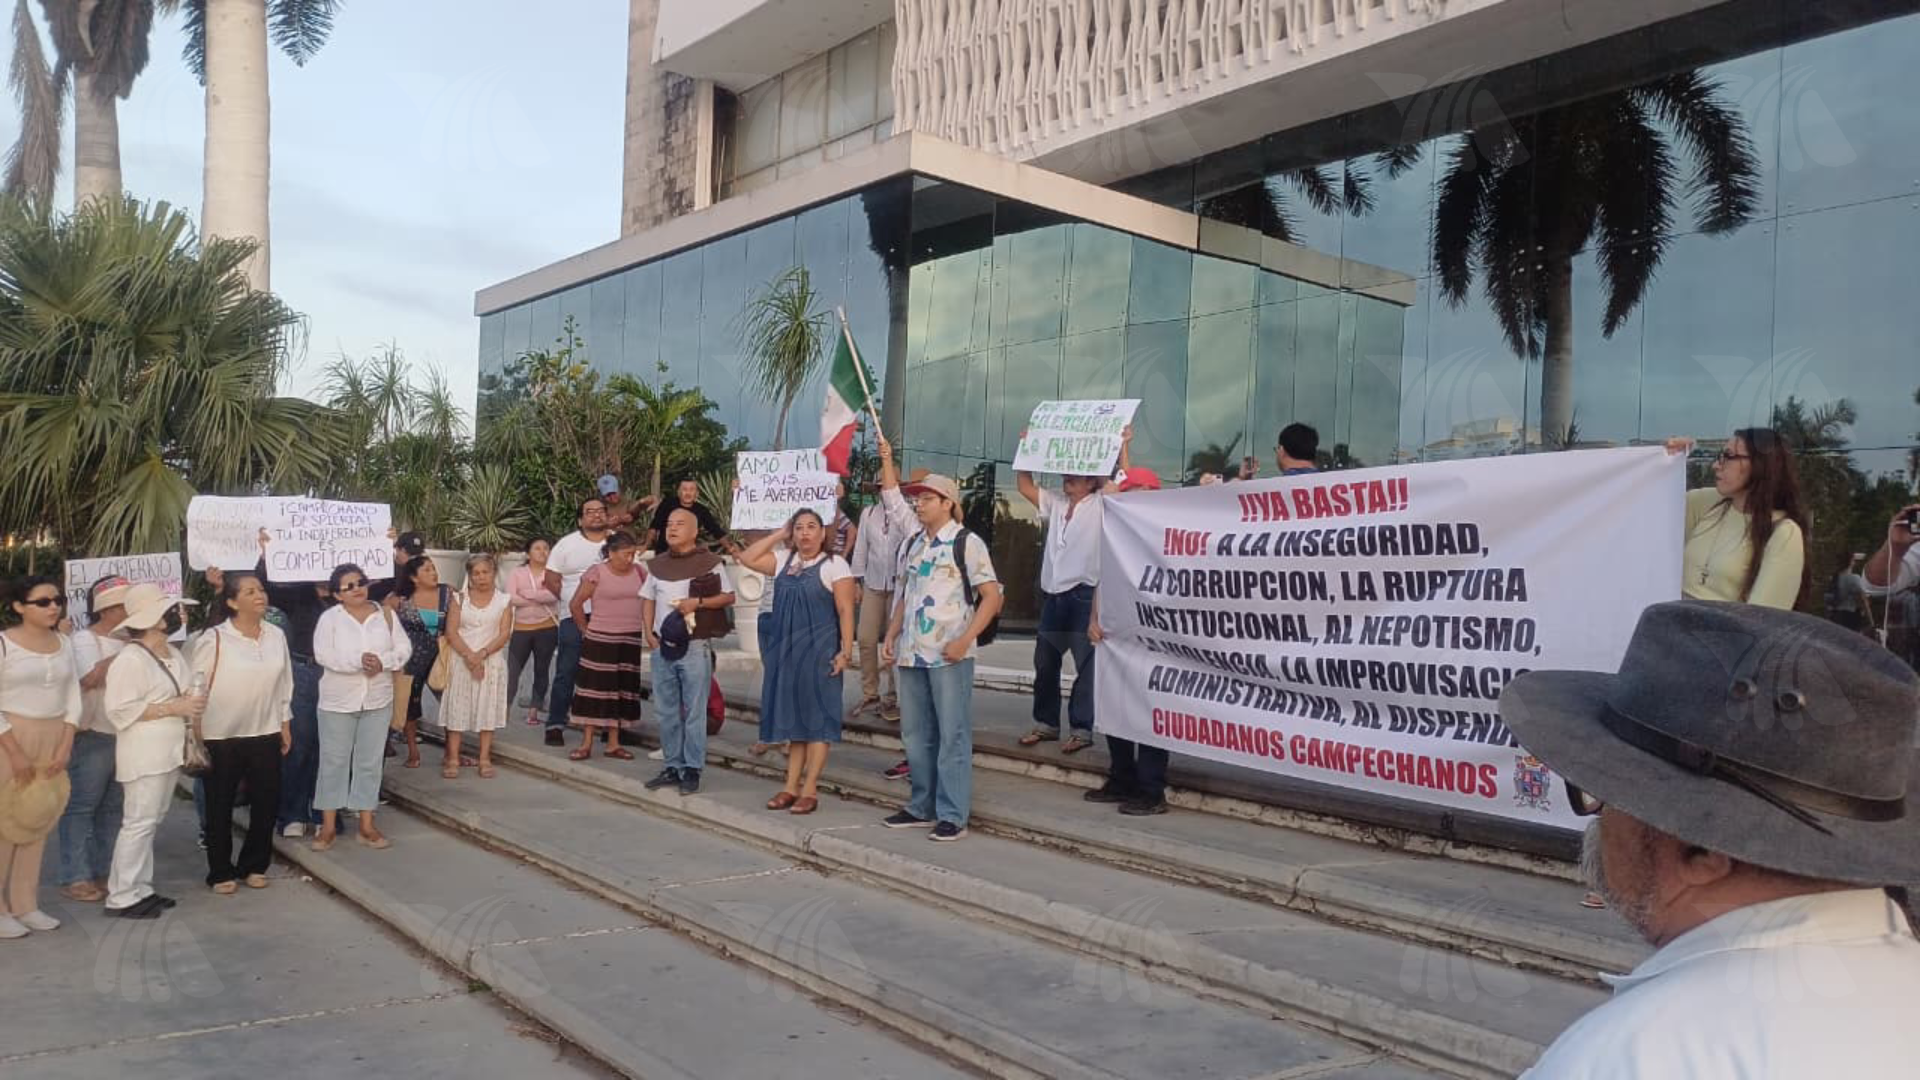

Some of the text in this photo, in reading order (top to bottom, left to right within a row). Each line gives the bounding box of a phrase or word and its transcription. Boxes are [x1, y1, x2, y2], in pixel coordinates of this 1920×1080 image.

[740, 452, 819, 474] AMO MI
[736, 486, 758, 503] ME
[1291, 477, 1408, 520] BASTA!!
[275, 529, 292, 540] TU
[319, 540, 335, 551] ES
[1216, 533, 1237, 557] A
[1238, 532, 1271, 557] LA
[1273, 522, 1489, 558] INSEGURIDAD,
[69, 562, 91, 586] EL
[272, 548, 388, 571] COMPLICIDAD
[1138, 565, 1528, 604] LA CORRUPCION, LA RUPTURA
[1135, 601, 1541, 656] INSTITUCIONAL, AL NEPOTISMO,
[1281, 655, 1314, 685] LA
[1148, 665, 1519, 748] ADMINISTRATIVA, AL DISPEND
[1152, 707, 1498, 799] CIUDADANOS CAMPECHANOS
